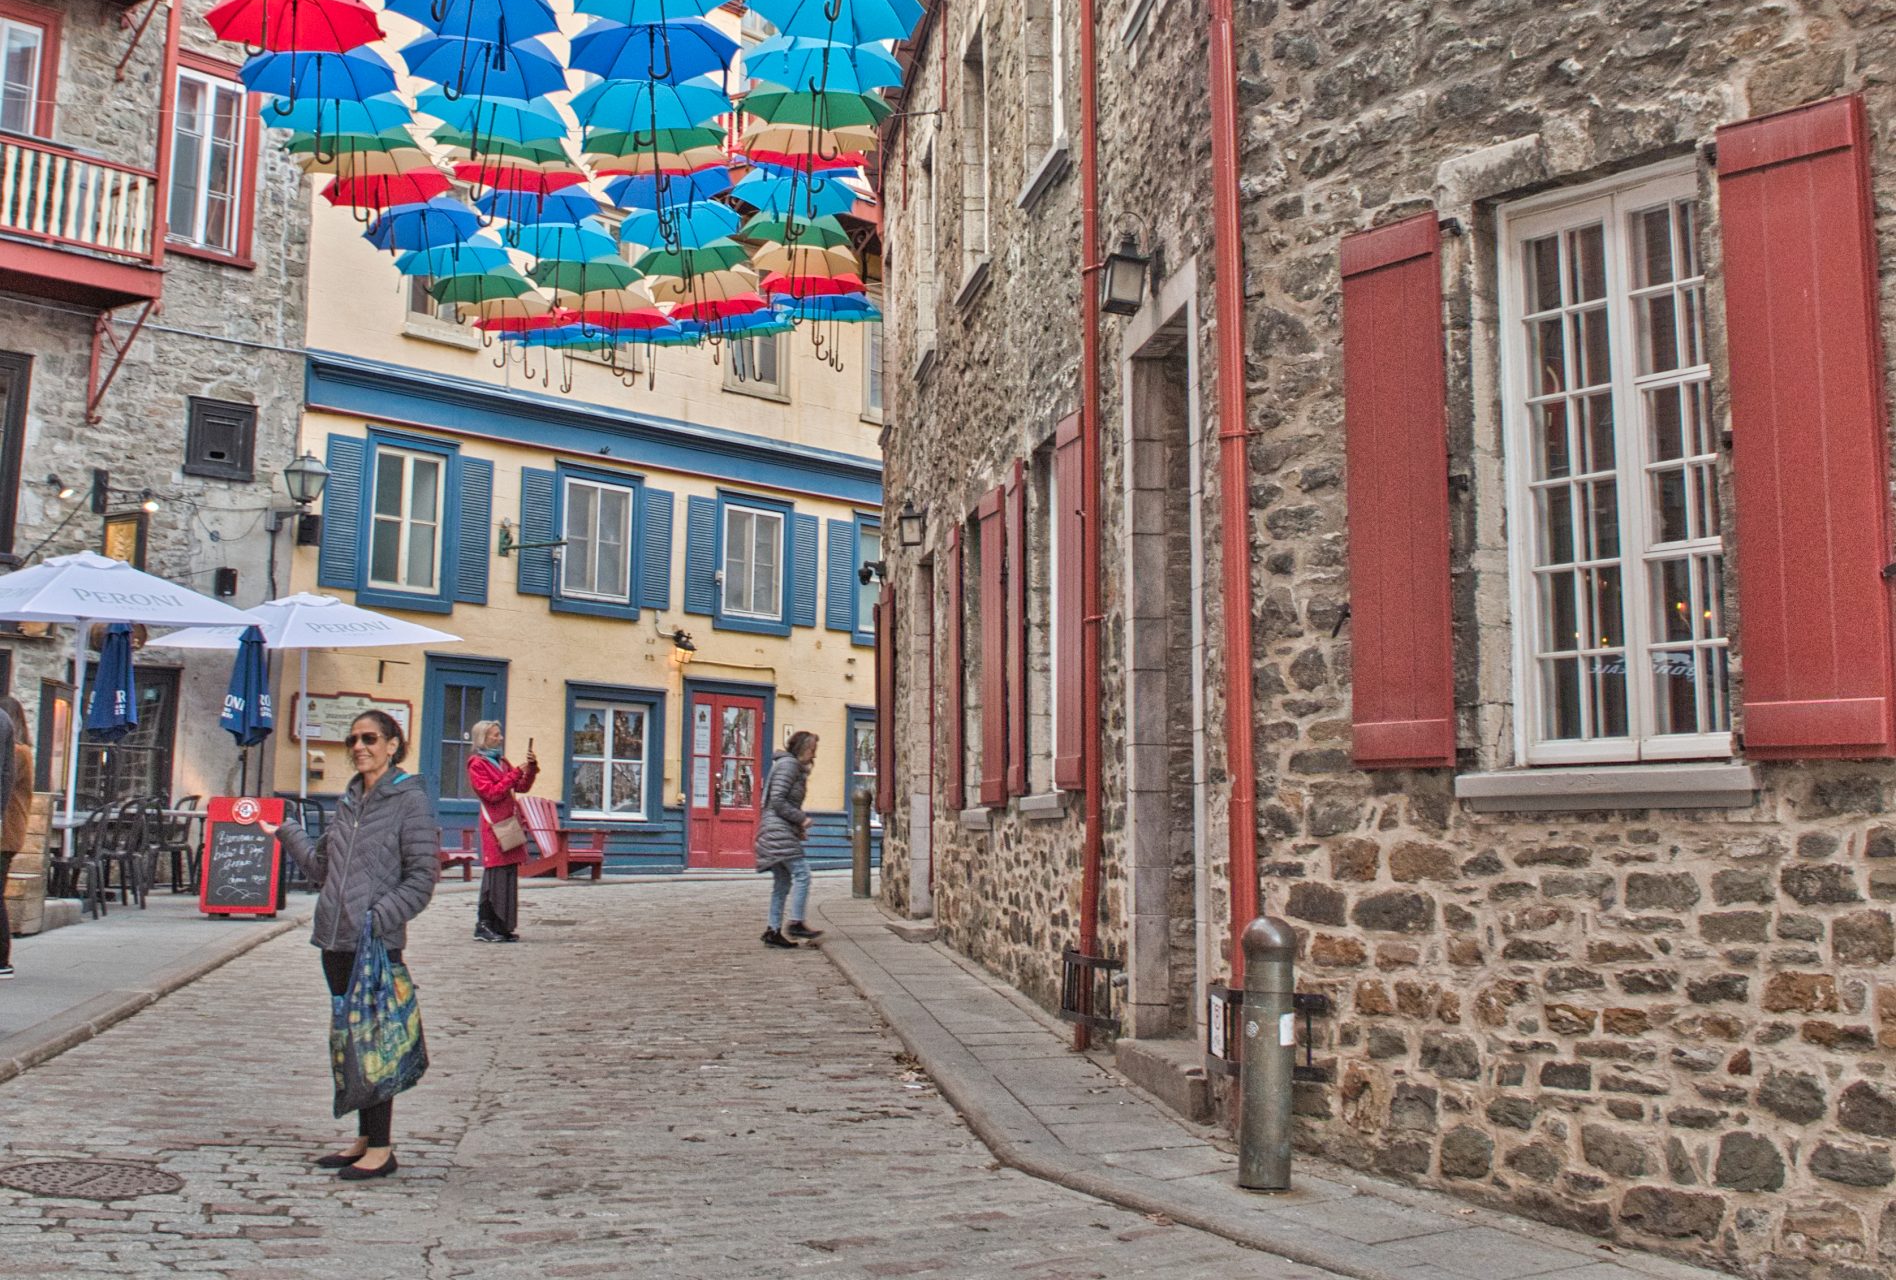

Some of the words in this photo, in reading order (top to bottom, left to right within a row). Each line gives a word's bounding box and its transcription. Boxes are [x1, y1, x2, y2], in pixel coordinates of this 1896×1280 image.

[72, 587, 184, 607] PERONI
[305, 620, 391, 634] PERONI
[224, 693, 246, 712] ONI
